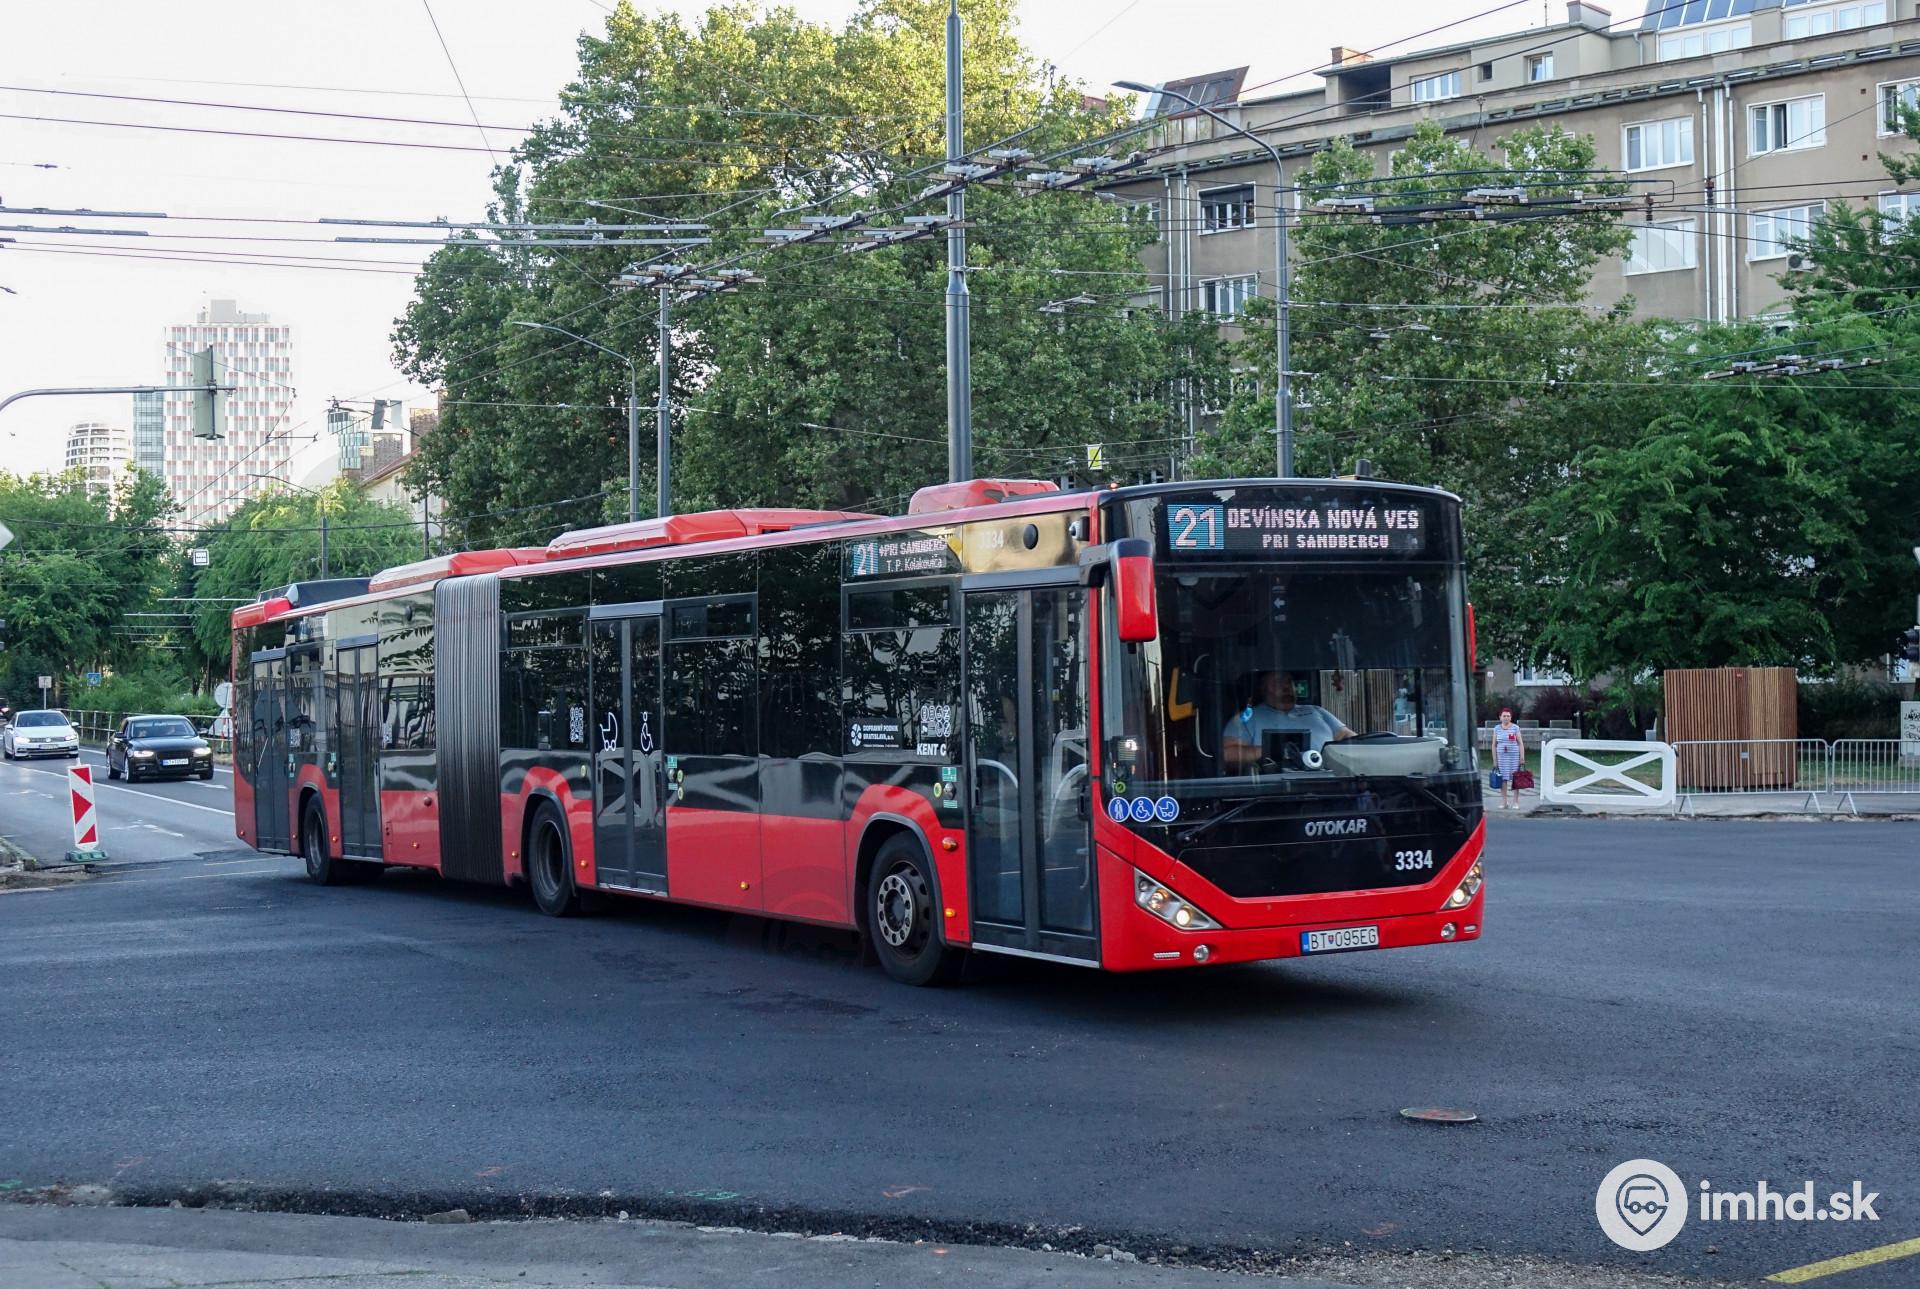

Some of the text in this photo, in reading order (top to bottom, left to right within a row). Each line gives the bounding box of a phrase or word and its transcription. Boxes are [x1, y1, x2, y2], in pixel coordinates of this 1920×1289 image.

[1174, 507, 1216, 547] 21
[1227, 505, 1419, 529] DEVÍNSKA NOVÁ VES
[1262, 534, 1389, 549] PRI SANDBERGU
[857, 543, 875, 576] 21
[916, 743, 947, 756] KENT C
[1304, 818, 1367, 837] OTOKAR
[1395, 849, 1433, 871] 3334
